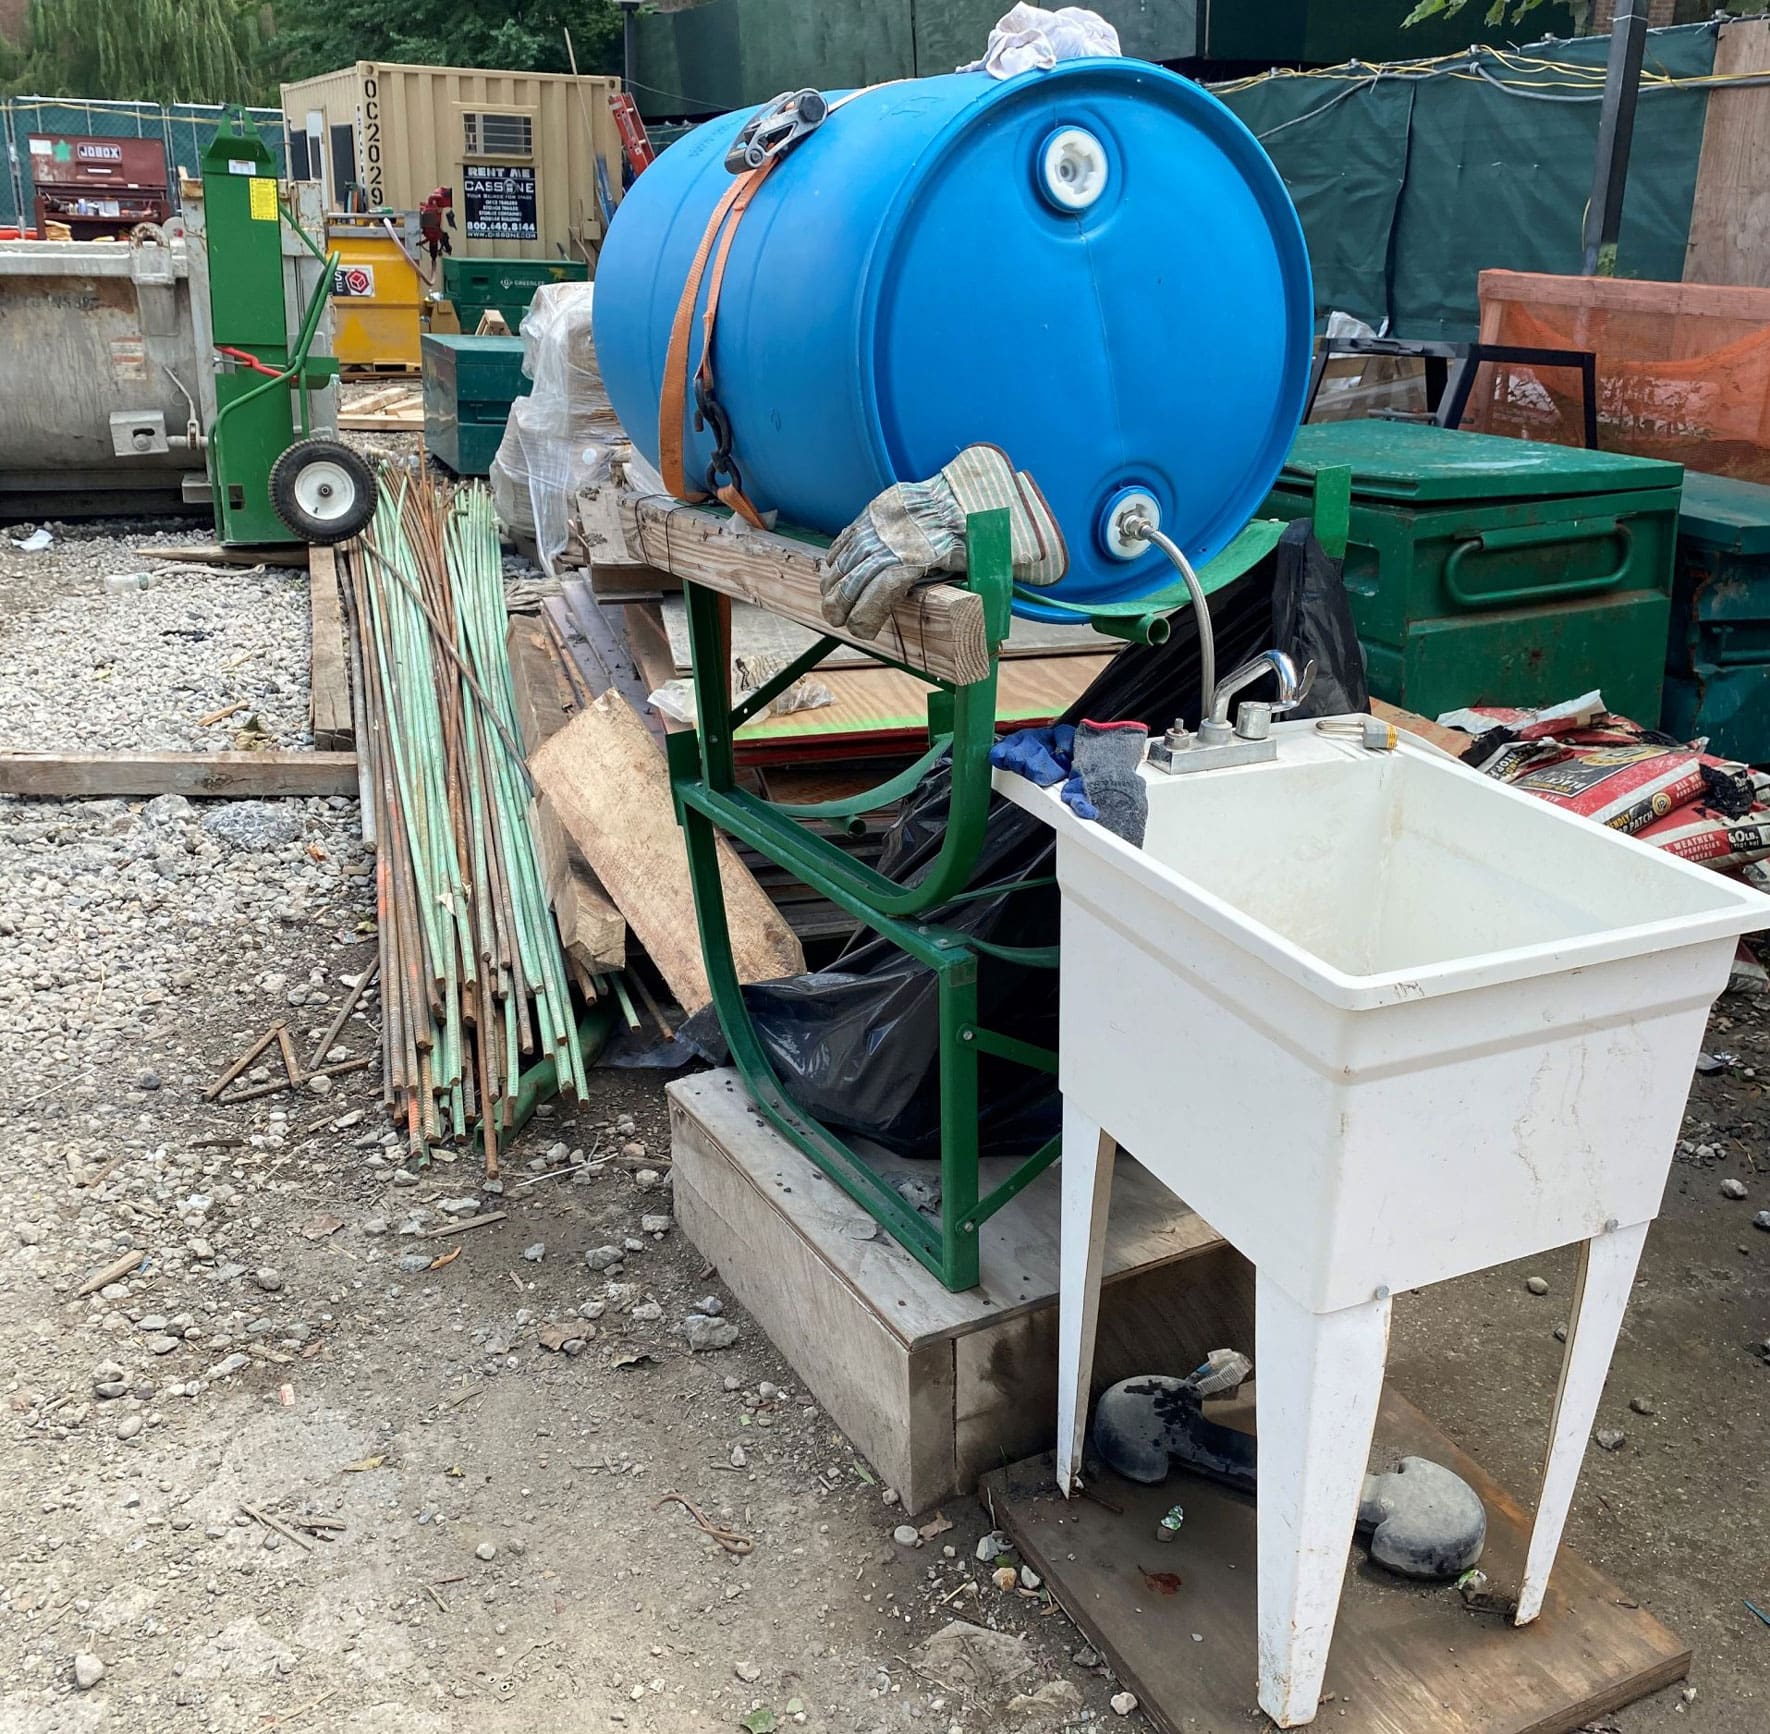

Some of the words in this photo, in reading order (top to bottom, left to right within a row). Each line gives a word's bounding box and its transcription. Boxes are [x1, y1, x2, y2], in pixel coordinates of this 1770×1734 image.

[80, 145, 119, 158] JOBOX
[467, 167, 504, 177] RENT
[509, 168, 530, 178] ME
[467, 221, 535, 232] 800.640.8144
[1630, 811, 1654, 832] PATCH
[1672, 833, 1714, 851] WEATHER
